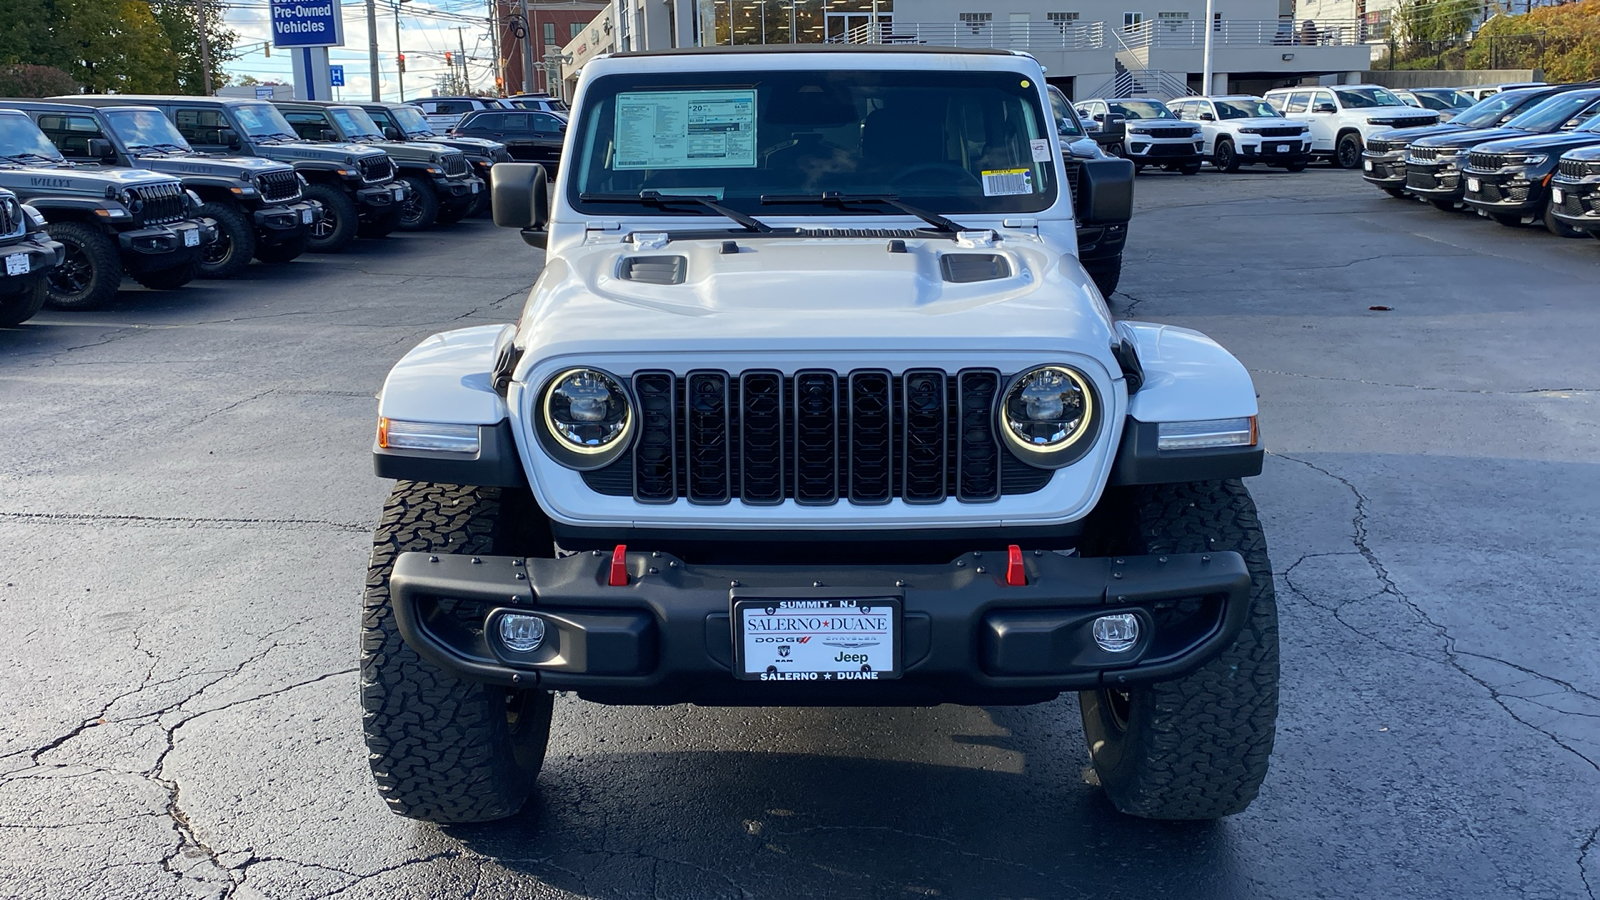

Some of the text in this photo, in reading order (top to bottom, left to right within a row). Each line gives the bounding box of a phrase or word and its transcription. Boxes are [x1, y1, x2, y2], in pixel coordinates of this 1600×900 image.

[274, 4, 331, 18] Pre-Owned
[275, 20, 325, 33] Vehicles
[332, 70, 341, 80] H
[179, 164, 213, 174] WILLYS
[31, 177, 72, 188] WILLYS
[840, 600, 857, 608] NJ
[748, 618, 887, 630] SALERNO DUANE
[834, 651, 869, 664] Jeep
[760, 672, 878, 681] SALERNO DUANE
